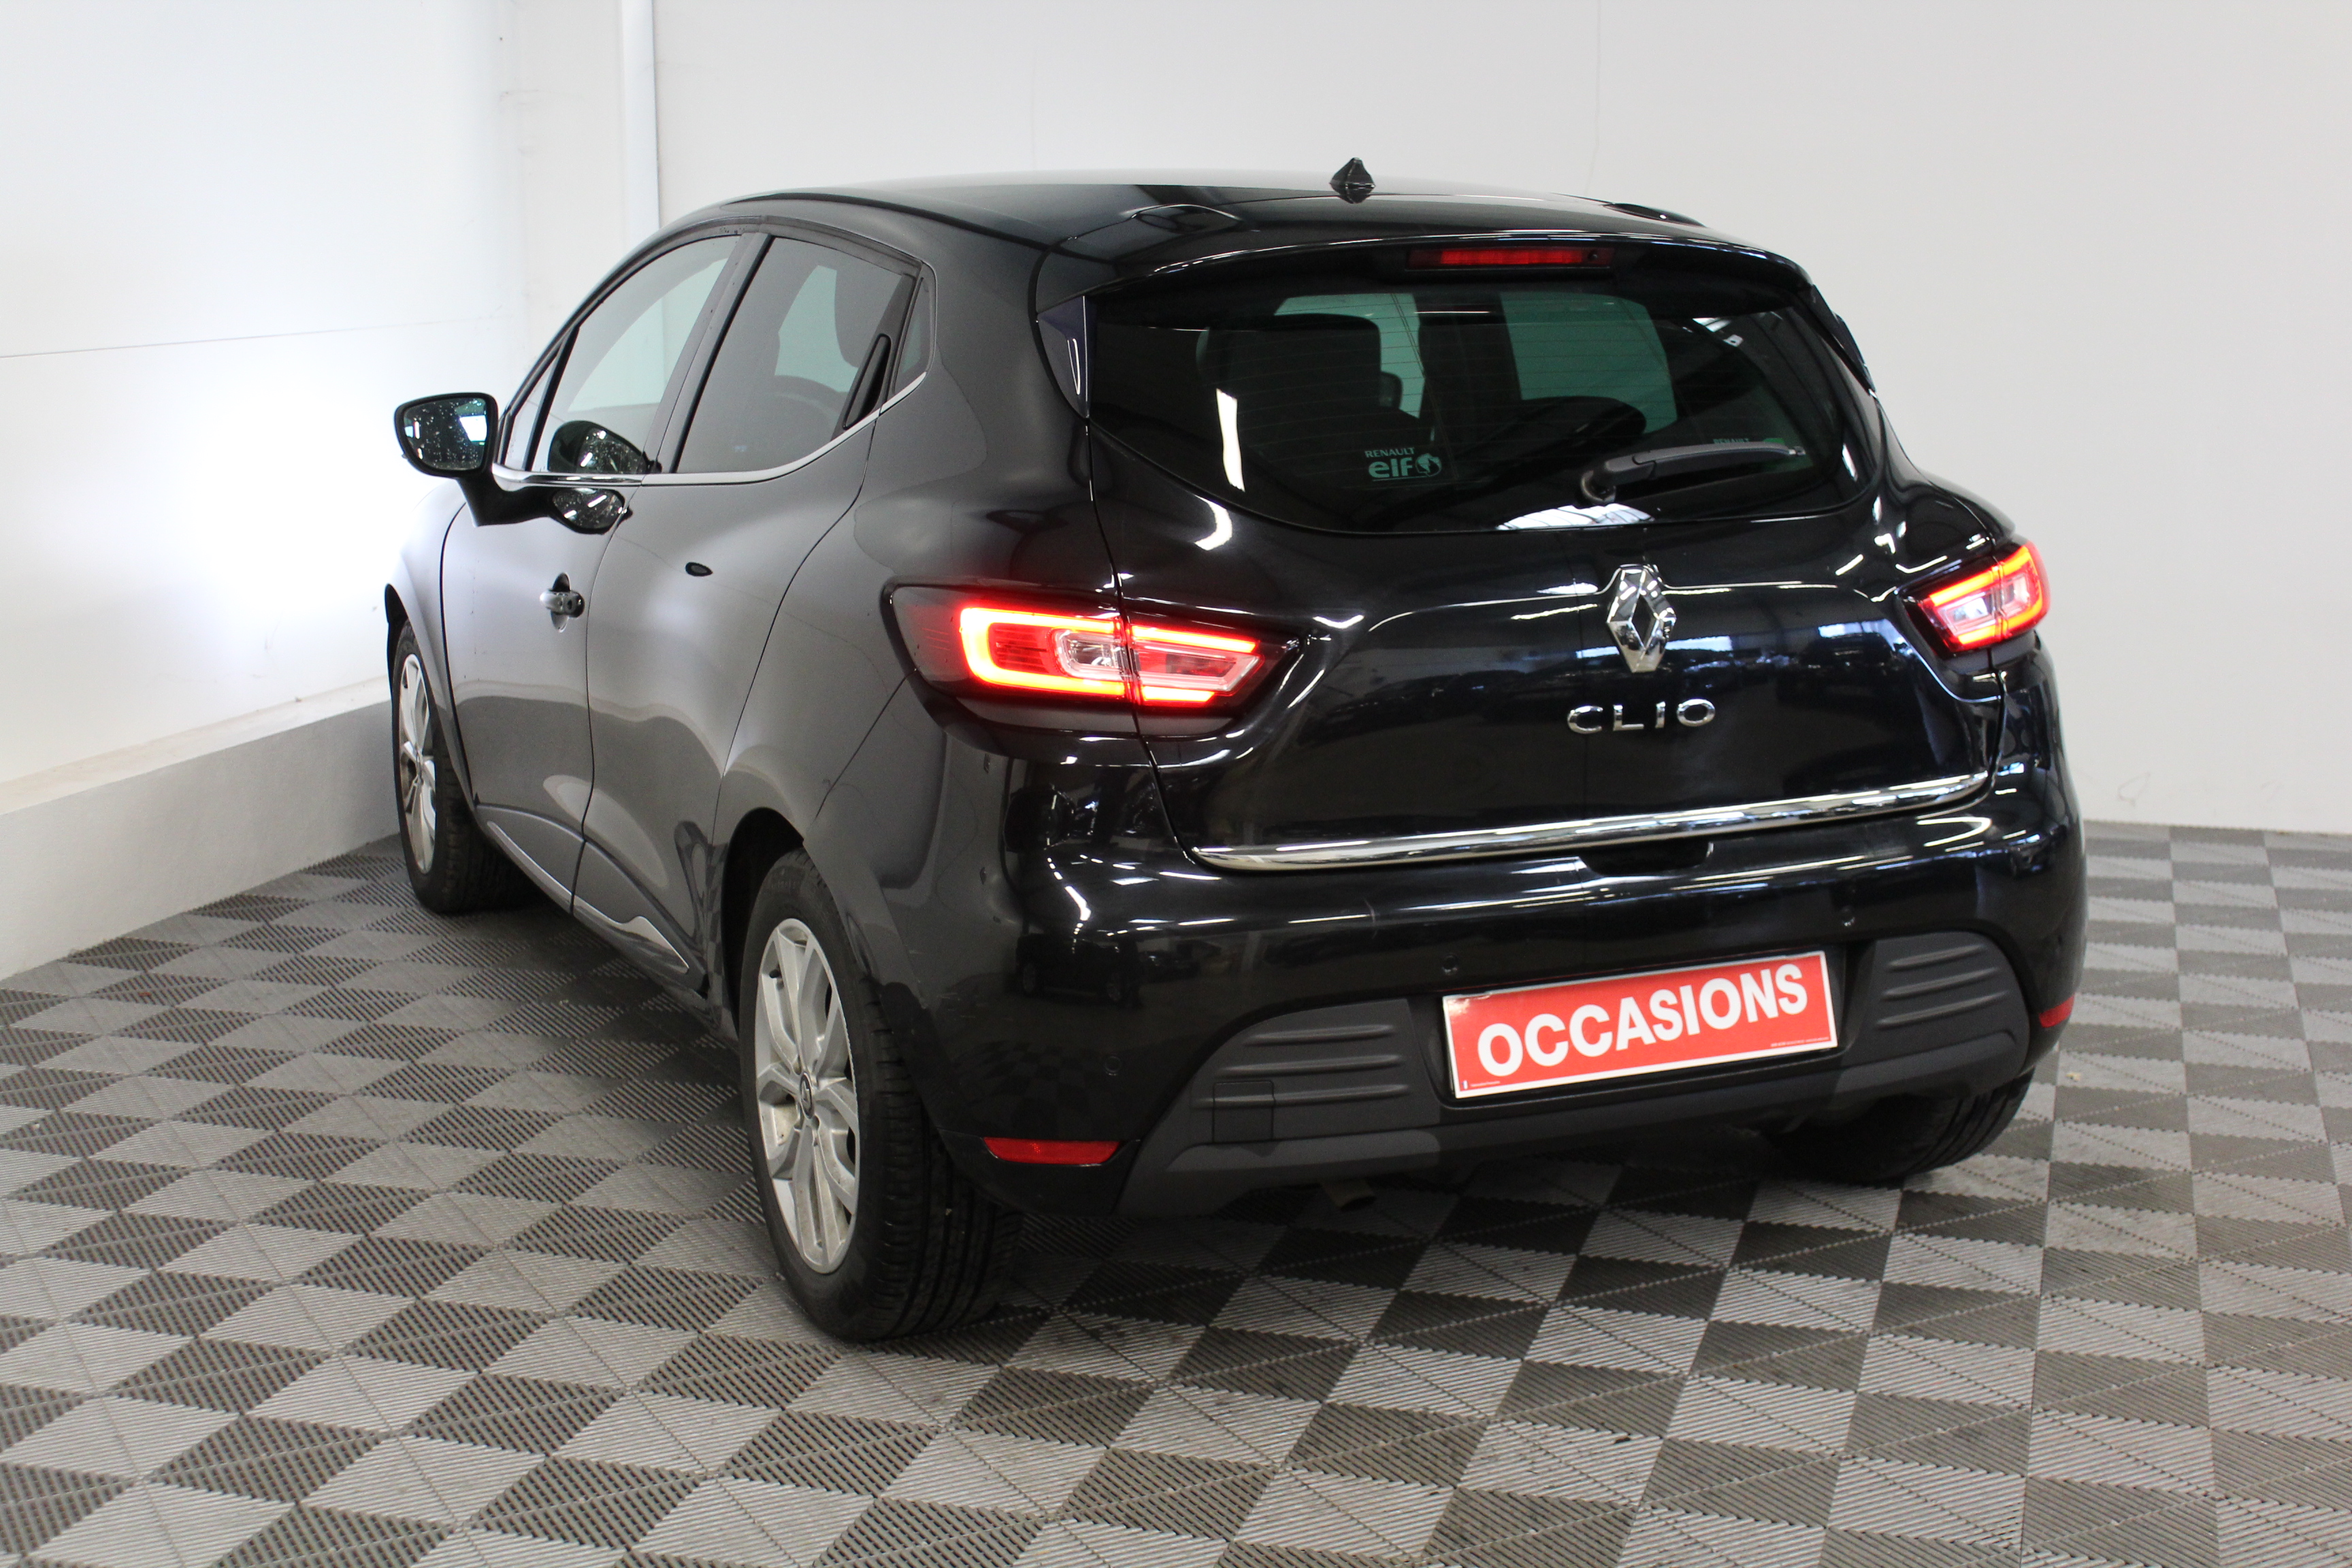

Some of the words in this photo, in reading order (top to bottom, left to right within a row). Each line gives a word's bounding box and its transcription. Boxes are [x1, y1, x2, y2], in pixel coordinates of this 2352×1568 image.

[1365, 447, 1415, 458] RENAULT
[1369, 457, 1412, 478] elf
[1567, 699, 1715, 734] CLIO
[1477, 964, 1808, 1077] OCCASIONS
